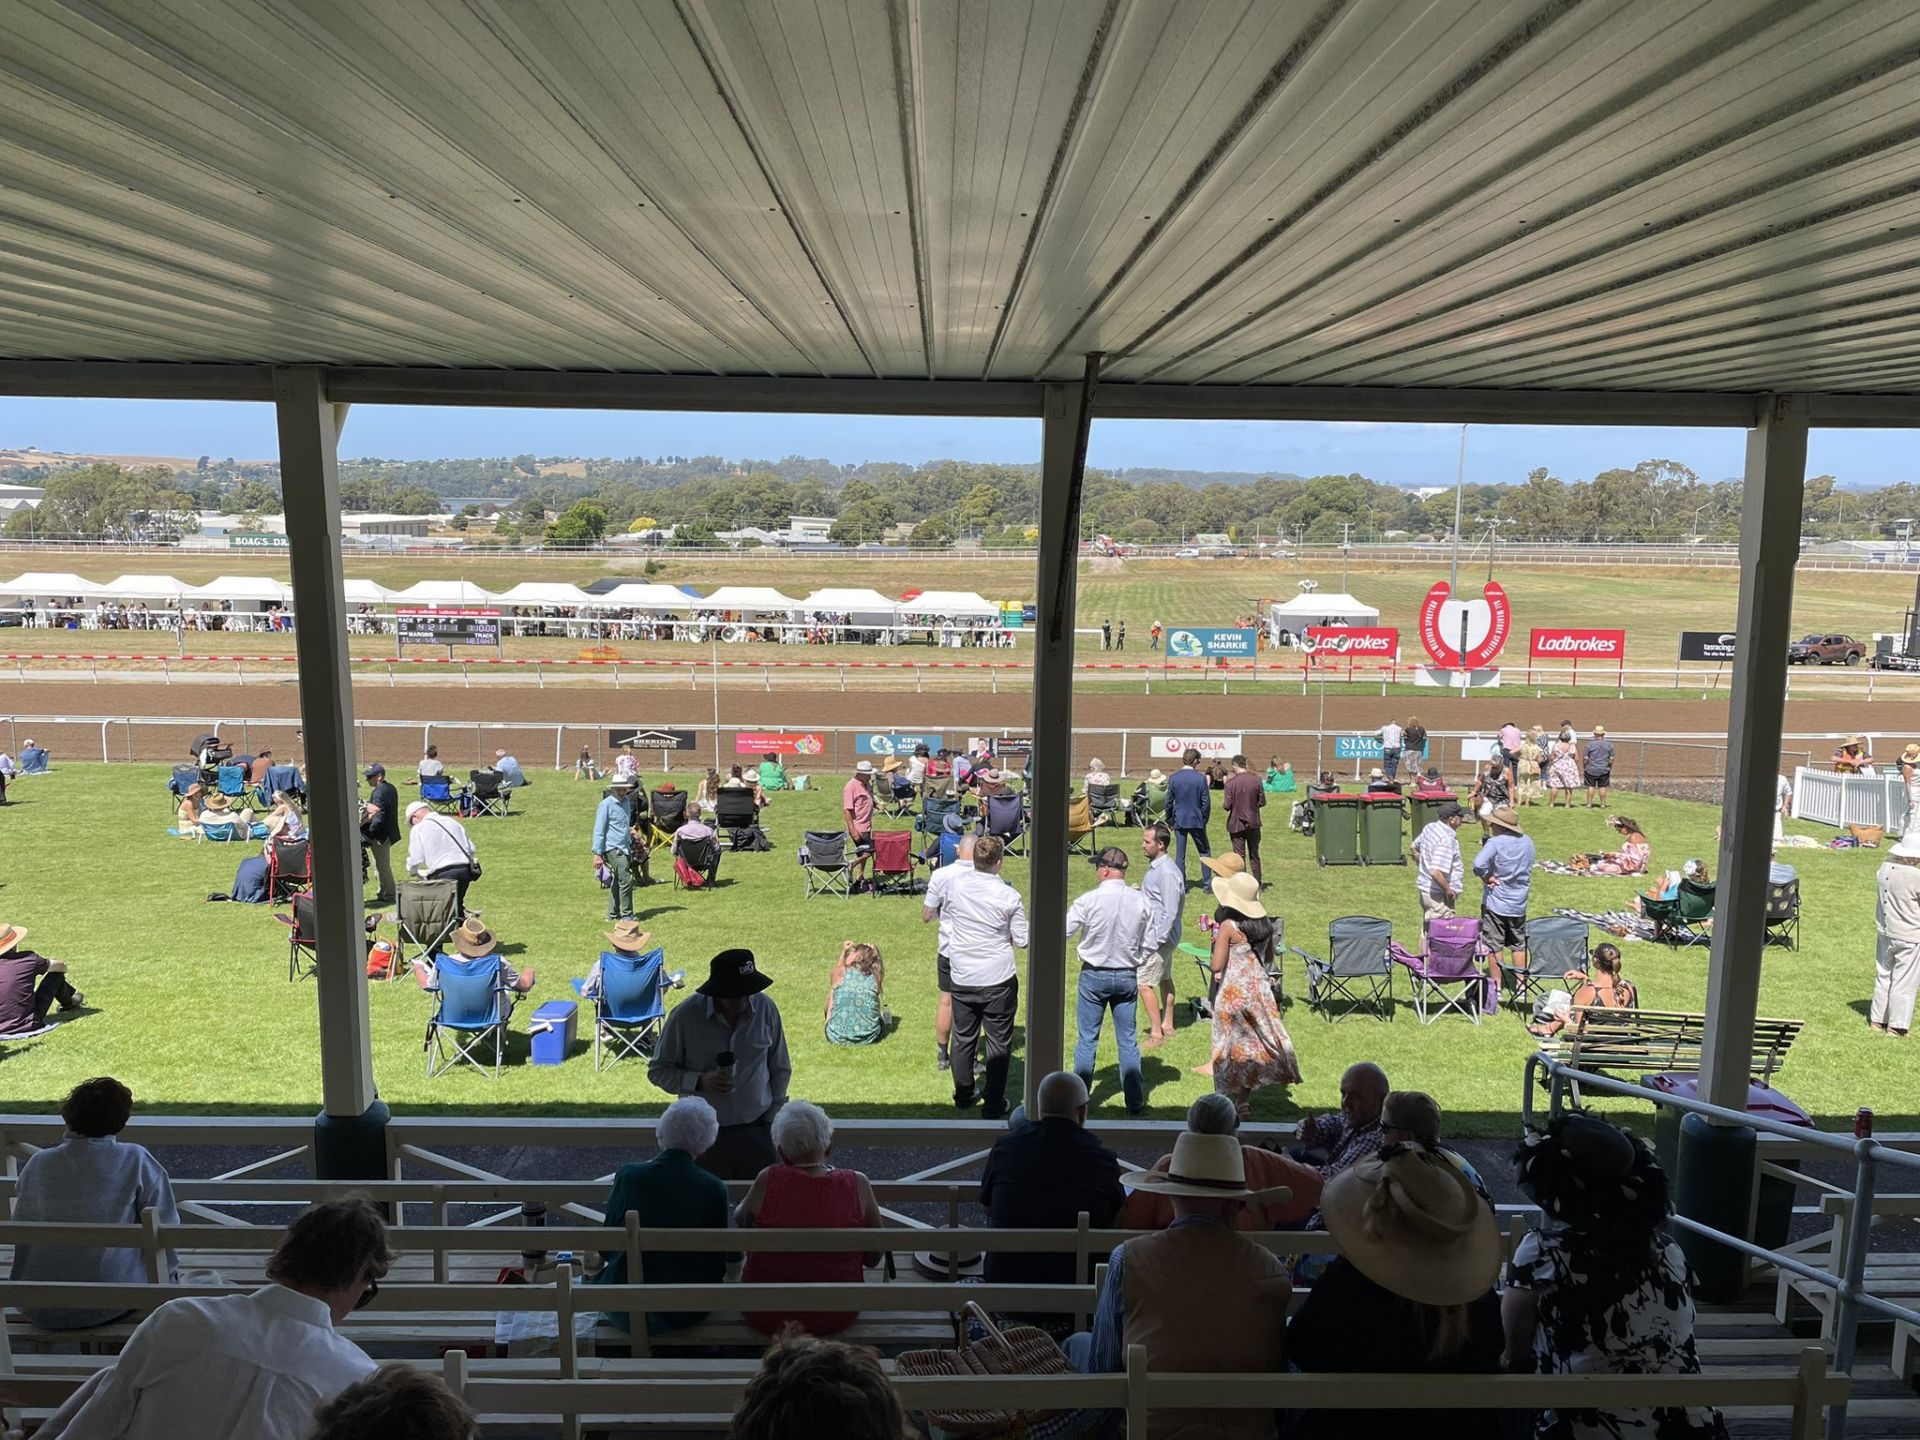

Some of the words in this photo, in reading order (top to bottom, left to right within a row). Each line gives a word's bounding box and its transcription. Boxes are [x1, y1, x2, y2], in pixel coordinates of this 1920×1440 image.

[273, 538, 290, 547] DR
[1213, 633, 1242, 641] KEVIN
[1207, 641, 1248, 649] SHARKIE
[1315, 634, 1390, 650] Larokes
[1537, 635, 1617, 652] Ladbrokes
[1183, 741, 1226, 750] VEOLIA
[1341, 738, 1385, 751] SIMO
